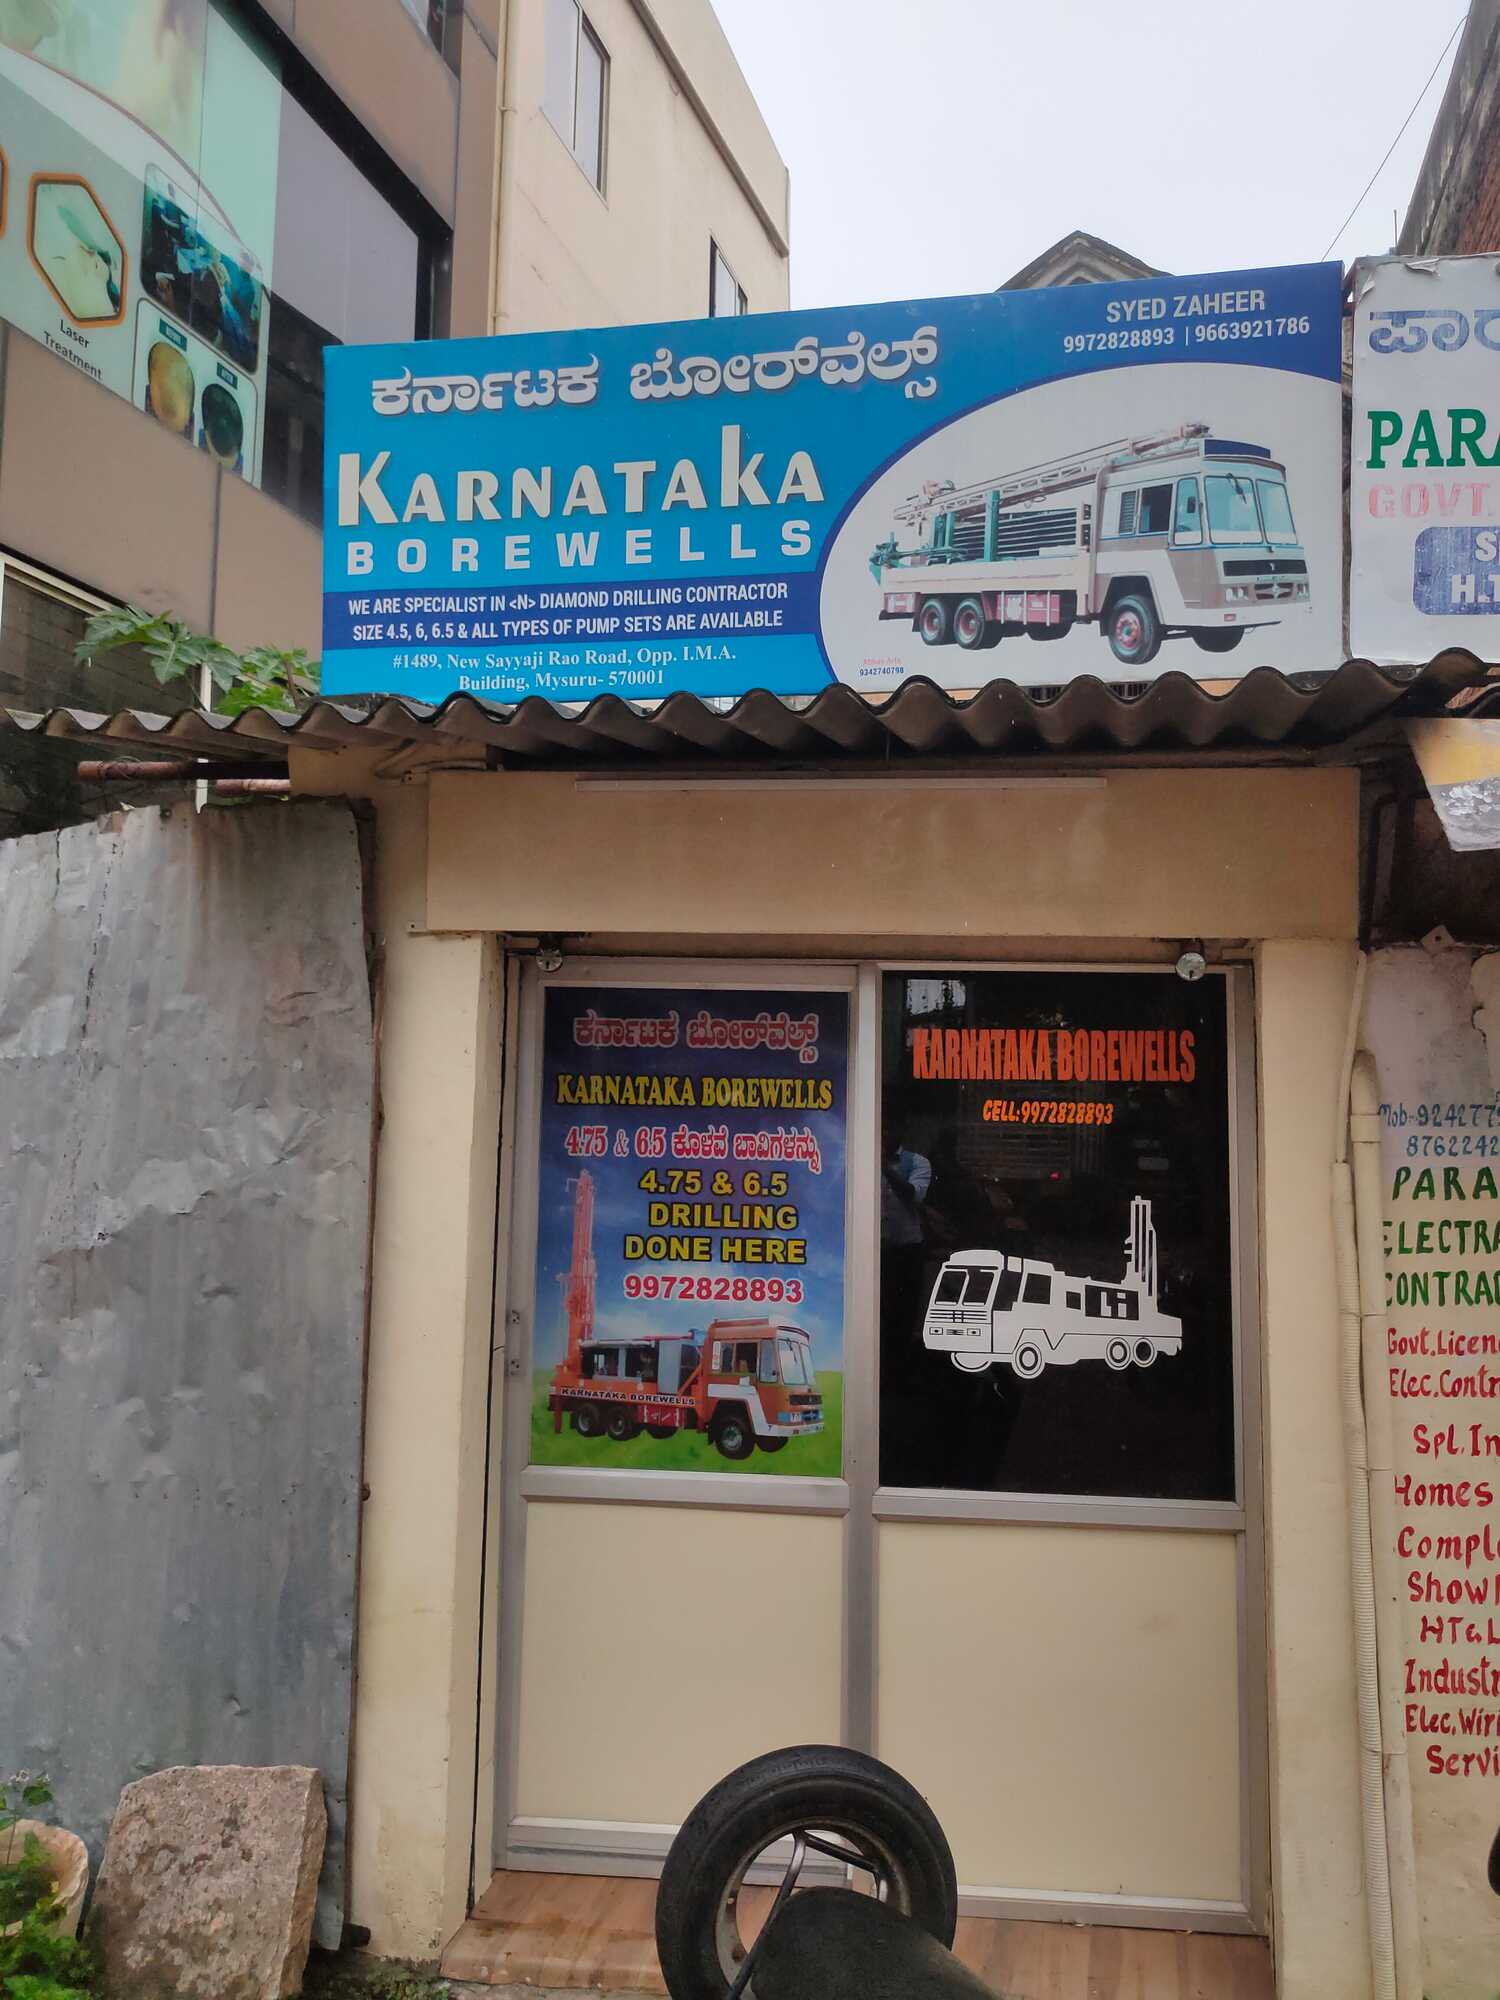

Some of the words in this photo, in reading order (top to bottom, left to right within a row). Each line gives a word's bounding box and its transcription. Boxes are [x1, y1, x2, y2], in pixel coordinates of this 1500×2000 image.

[1106, 298, 1166, 323] SYED
[1173, 289, 1265, 318] ZAHEER
[60, 319, 90, 349] Laser
[1063, 327, 1175, 353] 9972828893
[1195, 316, 1310, 342] 9663921786
[44, 331, 103, 380] Treatment
[372, 353, 599, 415] ಕರ್ನಾಟಕ
[347, 520, 811, 575] BOREWELLS
[1475, 531, 1500, 562] S
[349, 599, 370, 615] WE
[373, 598, 400, 614] ARE
[404, 596, 487, 613] SPECIALIST
[490, 595, 505, 611] IN
[540, 591, 608, 609] DIAMOND
[613, 587, 682, 607] DRILLING
[686, 582, 788, 603] CONTRACTOR
[353, 624, 383, 641] SIZE
[386, 623, 411, 641] 4.5,
[415, 623, 428, 641] 6,
[432, 622, 453, 639] 6.5
[457, 623, 468, 639] &
[472, 622, 498, 639] ALL
[502, 620, 549, 637] TYPES
[553, 619, 572, 635] OF
[576, 616, 620, 635] PUMP
[624, 615, 662, 633] SETS
[665, 613, 696, 631] ARE
[700, 610, 783, 629] AVAILABLE
[392, 654, 442, 670] #1489,
[447, 653, 480, 669] New
[485, 651, 544, 671] Sayyaji
[549, 651, 580, 666] Rao
[585, 650, 632, 667] Road,
[637, 647, 677, 667] Opp.
[683, 645, 737, 661] I.M.A.
[459, 675, 530, 693] Building,
[535, 672, 603, 691] Mysuru-
[608, 670, 664, 687] 570001
[574, 1009, 679, 1048] ಕರ್ನಾಟಕ
[912, 1028, 1052, 1080] KARNATAKA
[1057, 1029, 1196, 1082] BOREWELLS
[557, 1075, 696, 1106] KARNATAKA
[701, 1077, 833, 1110] BOREWELLS
[614, 1129, 629, 1157] &
[640, 1170, 701, 1194] 4.75
[712, 1172, 734, 1196] &
[744, 1172, 789, 1197] 6.5
[1392, 1166, 1498, 1200] PARA
[650, 1203, 799, 1230] DRILLING
[624, 1236, 712, 1262] DONE
[722, 1237, 807, 1264] HERE
[624, 1275, 804, 1304] 9972828893
[1394, 1474, 1494, 1507] Homes
[1397, 1523, 1500, 1569] Compl
